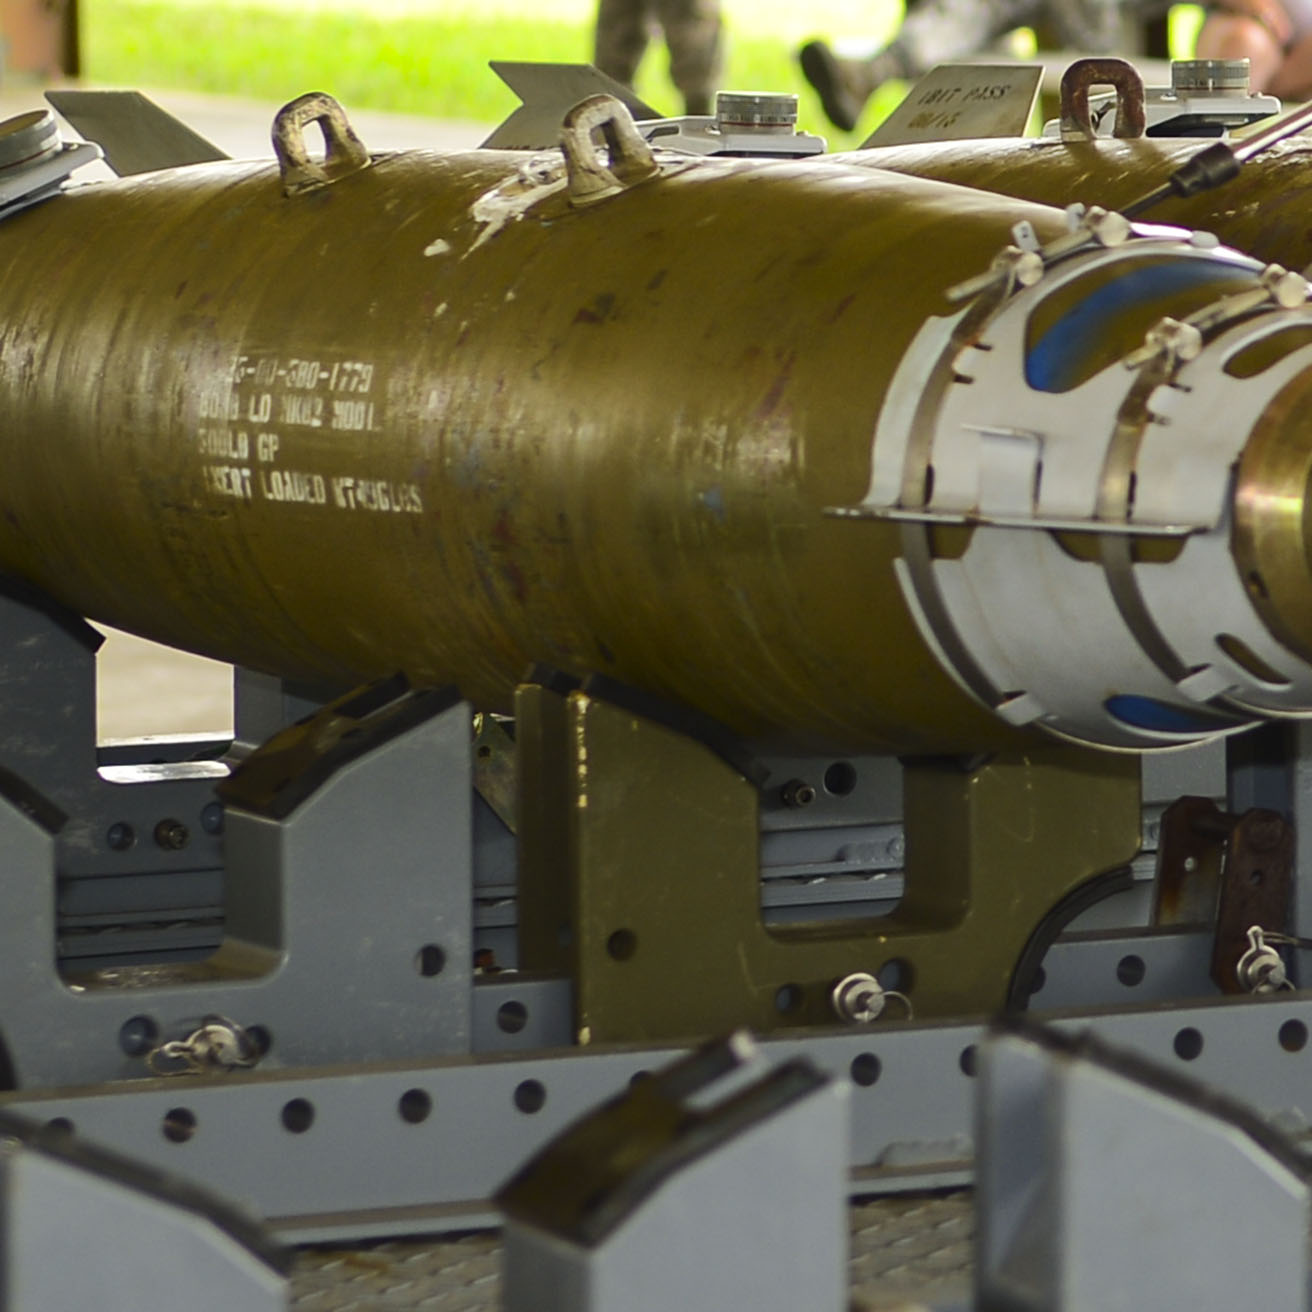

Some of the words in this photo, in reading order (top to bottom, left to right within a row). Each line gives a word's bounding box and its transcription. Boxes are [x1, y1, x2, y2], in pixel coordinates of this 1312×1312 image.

[962, 84, 1012, 101] PASS
[257, 432, 280, 463] GP
[259, 468, 327, 505] LOADED
